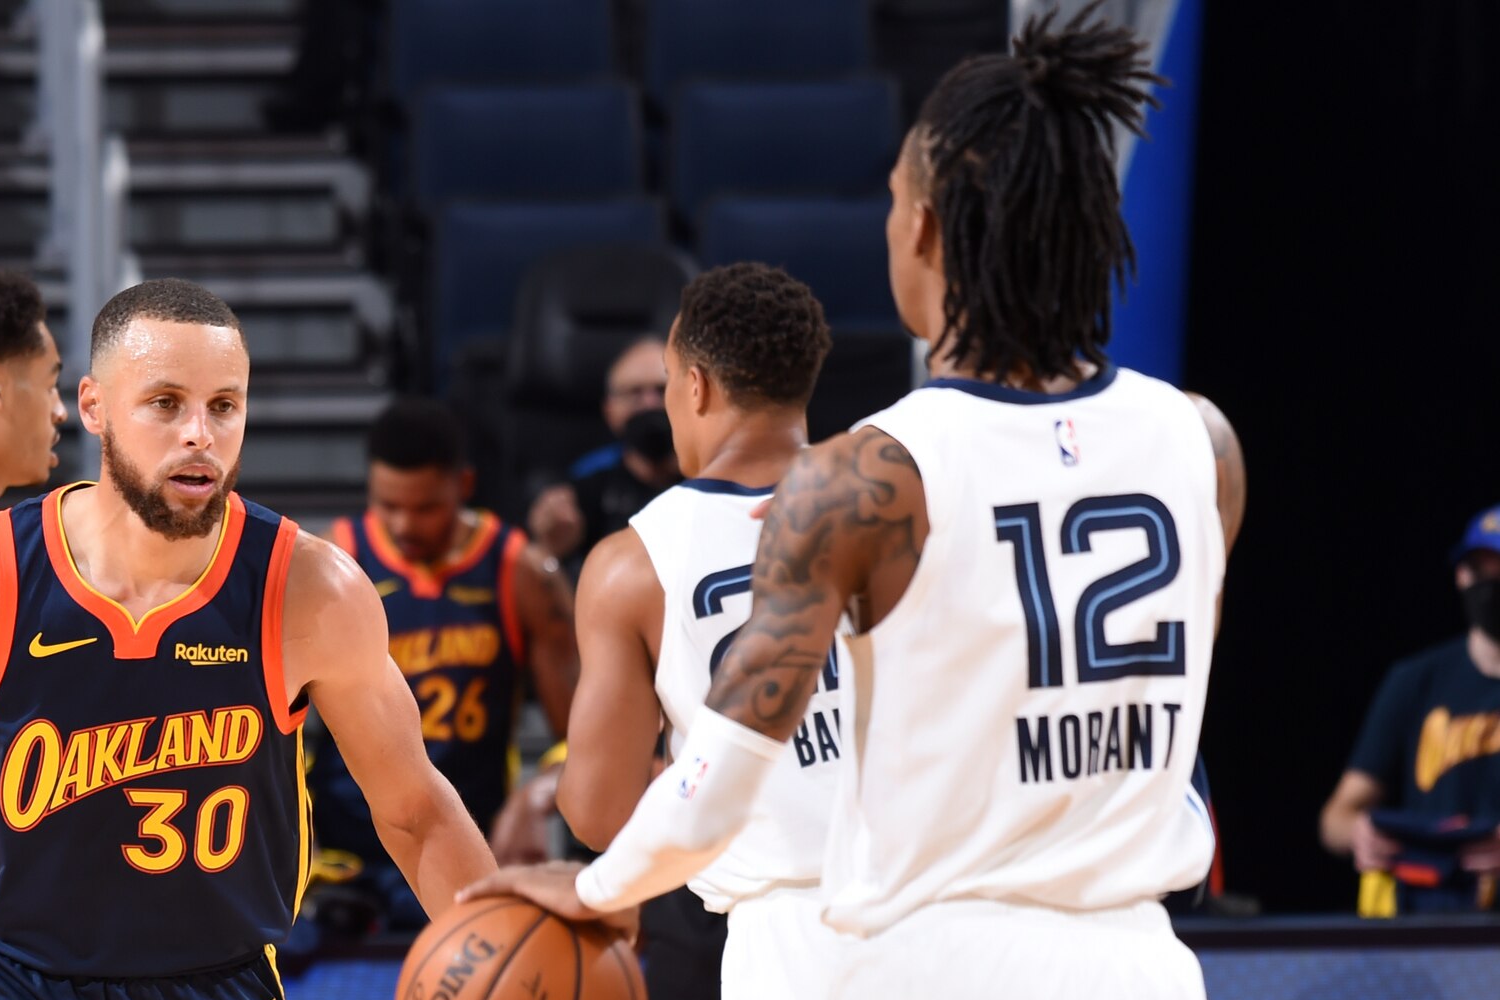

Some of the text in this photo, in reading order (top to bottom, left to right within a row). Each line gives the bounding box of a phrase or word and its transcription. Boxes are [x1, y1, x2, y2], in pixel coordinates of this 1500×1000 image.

[994, 493, 1186, 689] 12
[174, 643, 249, 663] Rakuten
[417, 674, 487, 742] 26
[1016, 703, 1182, 784] MORANT
[0, 704, 263, 832] OAKLAND
[121, 785, 249, 874] 30
